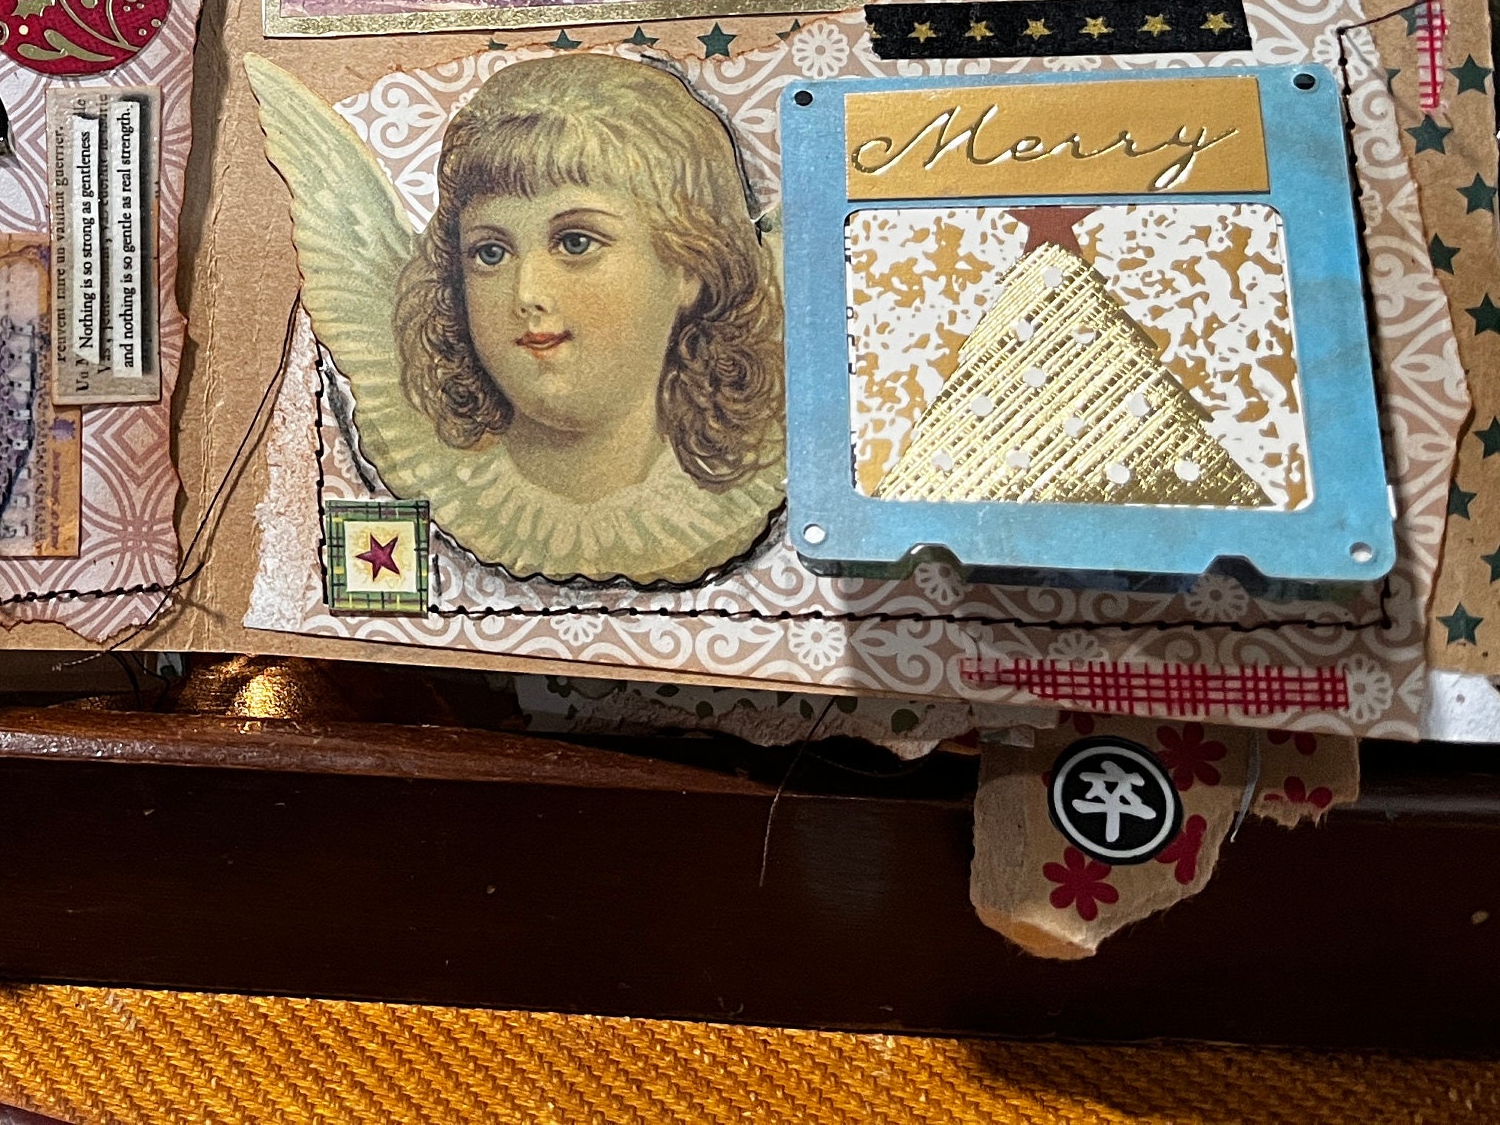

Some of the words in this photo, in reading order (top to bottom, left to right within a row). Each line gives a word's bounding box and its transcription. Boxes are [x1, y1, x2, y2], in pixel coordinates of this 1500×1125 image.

[115, 108, 134, 166] strength.
[851, 104, 1239, 192] Merry
[77, 131, 95, 198] gentleness
[117, 169, 132, 193] real
[82, 202, 93, 214] as
[119, 197, 132, 210] as
[79, 217, 95, 258] strong
[117, 213, 136, 253] gentle
[81, 261, 93, 276] so
[121, 256, 133, 271] so
[80, 278, 92, 289] is
[119, 272, 133, 284] is
[78, 292, 96, 349] Nothing
[118, 287, 137, 340] nothing
[119, 344, 134, 368] and
